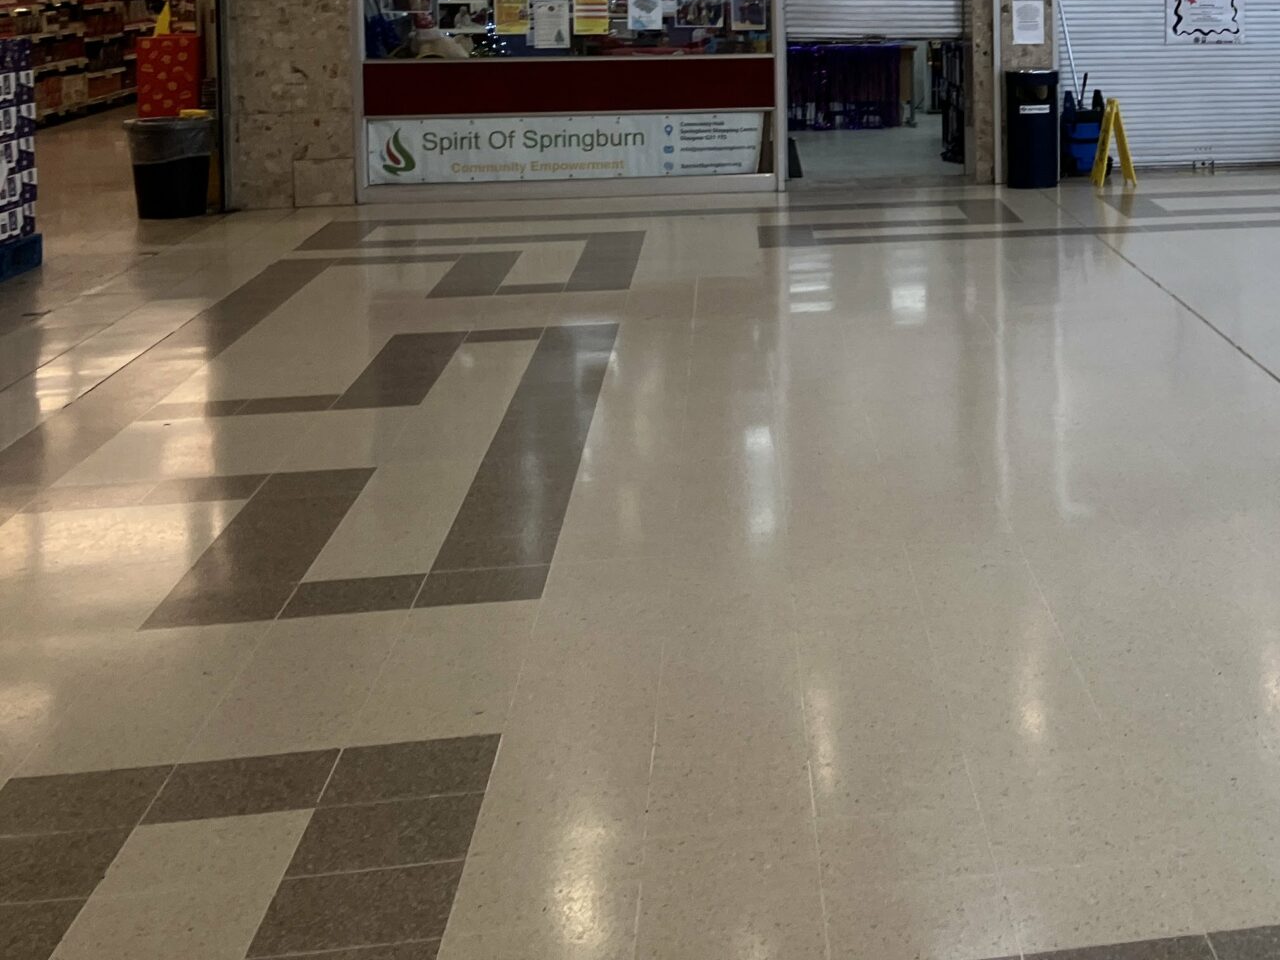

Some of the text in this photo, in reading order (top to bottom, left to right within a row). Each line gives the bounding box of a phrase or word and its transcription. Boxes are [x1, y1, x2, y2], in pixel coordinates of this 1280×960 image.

[421, 127, 645, 155] Spirit Of Springburn
[450, 158, 625, 177] Community Empowerment
